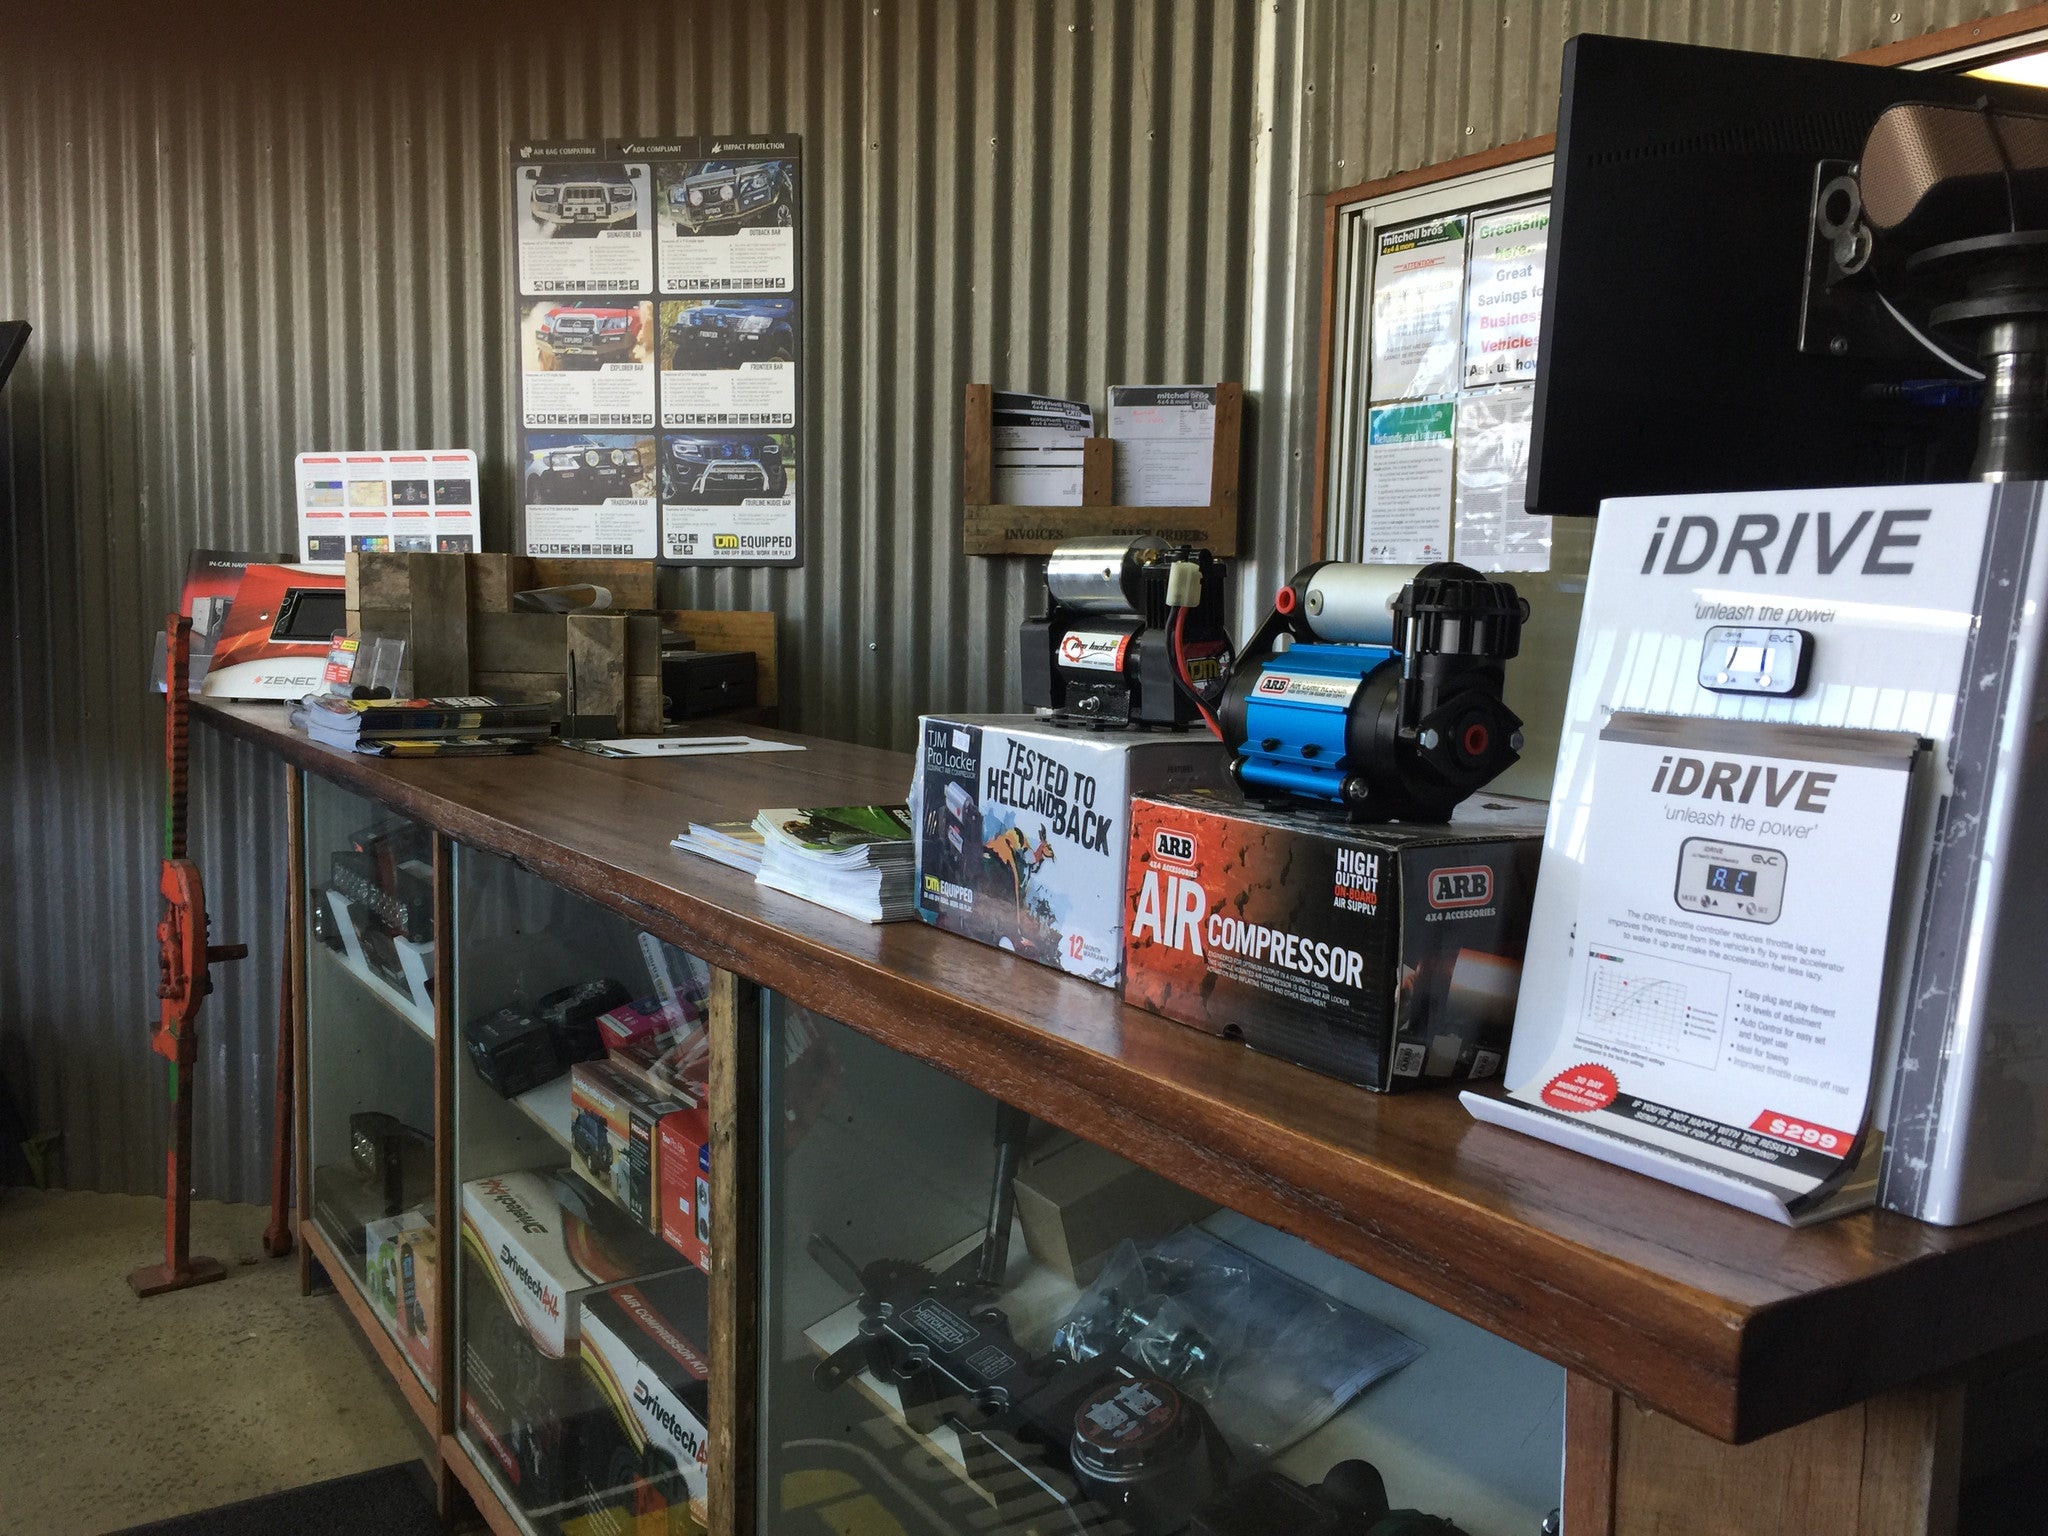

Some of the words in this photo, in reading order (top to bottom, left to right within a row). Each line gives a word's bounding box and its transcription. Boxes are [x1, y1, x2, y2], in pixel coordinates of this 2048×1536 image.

[559, 147, 596, 155] COMPATIBLE
[647, 145, 681, 153] COMPLIANT
[723, 143, 745, 151] IMPACT
[747, 142, 785, 150] PROTECTION
[633, 230, 642, 238] BAR
[771, 228, 781, 236] BAR
[1383, 228, 1419, 246] mitchell
[1420, 225, 1443, 238] bros
[1382, 244, 1394, 254] 4x4
[1403, 259, 1435, 269] ATTENTION
[1496, 264, 1533, 281] Great
[1478, 290, 1527, 306] Savings
[1480, 335, 1540, 353] Vehicles
[610, 364, 633, 372] EXPLORER
[751, 363, 773, 371] FRONTIER
[774, 363, 783, 371] BAR
[1497, 362, 1511, 373] us
[1157, 391, 1190, 399] mitchell
[1374, 431, 1402, 444] Refunds
[1403, 431, 1417, 442] and
[741, 535, 792, 548] EQUIPPED
[1004, 528, 1064, 541] INVOICES
[1156, 528, 1208, 541] ORDERS
[1640, 508, 1932, 576] iDRIVE
[1760, 604, 1784, 622] the
[263, 676, 317, 686] ZENEC
[1262, 679, 1287, 691] ARB
[928, 730, 947, 749] TJM
[927, 747, 943, 765] Pro
[945, 750, 976, 771] Locker
[1006, 738, 1069, 798] TESTED
[1074, 771, 1096, 809] TO
[1651, 756, 1837, 814] iDRIVE
[1729, 812, 1756, 831] the
[1157, 833, 1193, 860] ARB
[1149, 861, 1161, 870] 4X4
[1162, 863, 1198, 880] ACCESSORIES
[1337, 848, 1379, 878] HIGH
[1335, 871, 1378, 893] OUTPUT
[1436, 872, 1488, 900] ARB
[940, 880, 973, 904] EQUIPPED
[1334, 885, 1378, 906] ON-BOARD
[1333, 897, 1346, 909] AIR
[1347, 898, 1377, 916] SUPPLY
[1425, 911, 1443, 922] 4X4
[1445, 907, 1496, 922] ACCESSORIES
[1132, 870, 1206, 957] AIR
[1208, 913, 1364, 989] COMPRESSOR
[1628, 909, 1640, 919] The
[1642, 912, 1667, 925] iDRIVE
[1669, 918, 1694, 930] throttle
[1696, 925, 1730, 937] controller
[1732, 931, 1763, 943] reduces
[1766, 938, 1793, 950] throttle
[1795, 942, 1808, 955] lag
[1810, 947, 1826, 957] and
[1069, 934, 1084, 960] 12
[1083, 950, 1109, 963] WARRANTY
[1744, 988, 1761, 1001] Easy
[1762, 994, 1777, 1006] plug
[1779, 998, 1792, 1008] and
[1794, 1001, 1809, 1013] play
[1810, 1004, 1836, 1018] fitment
[1743, 1003, 1751, 1013] 18
[1753, 1006, 1772, 1018] levels
[1773, 1011, 1781, 1019] of
[1782, 1014, 1822, 1029] adjustment
[1738, 1030, 1751, 1040] and
[1753, 1033, 1773, 1046] forget
[1775, 1039, 1788, 1049] use
[1740, 1017, 1756, 1028] Auto
[1758, 1021, 1783, 1035] Control
[1784, 1027, 1794, 1037] for
[1796, 1032, 1812, 1044] easy
[1814, 1036, 1826, 1046] set
[1736, 1043, 1752, 1055] Ideal
[1754, 1047, 1764, 1057] for
[1765, 1051, 1789, 1066] towing
[1586, 1079, 1605, 1090] DAY
[1733, 1057, 1765, 1073] Improved
[1766, 1065, 1792, 1080] throttle
[1793, 1074, 1818, 1087] control
[1819, 1080, 1831, 1090] off
[1832, 1084, 1849, 1096] road
[1549, 1088, 1599, 1108] GUARANTEE
[1555, 1080, 1586, 1095] MONEY
[1584, 1089, 1609, 1102] BACK
[1634, 1111, 1658, 1124] SEND
[1657, 1118, 1668, 1126] IT
[1666, 1120, 1691, 1134] BACK
[1690, 1128, 1709, 1140] FOR
[1708, 1133, 1717, 1142] A
[1716, 1136, 1738, 1149] FULL
[1670, 1110, 1690, 1123] NOT
[1688, 1116, 1718, 1132] HAPPY
[1718, 1125, 1742, 1139] WITH
[1741, 1132, 1760, 1145] THE
[1759, 1138, 1800, 1157] RESULTS
[1768, 1117, 1838, 1150] $299
[620, 1293, 641, 1308] AIR
[634, 1307, 697, 1361] COMPRESSOR
